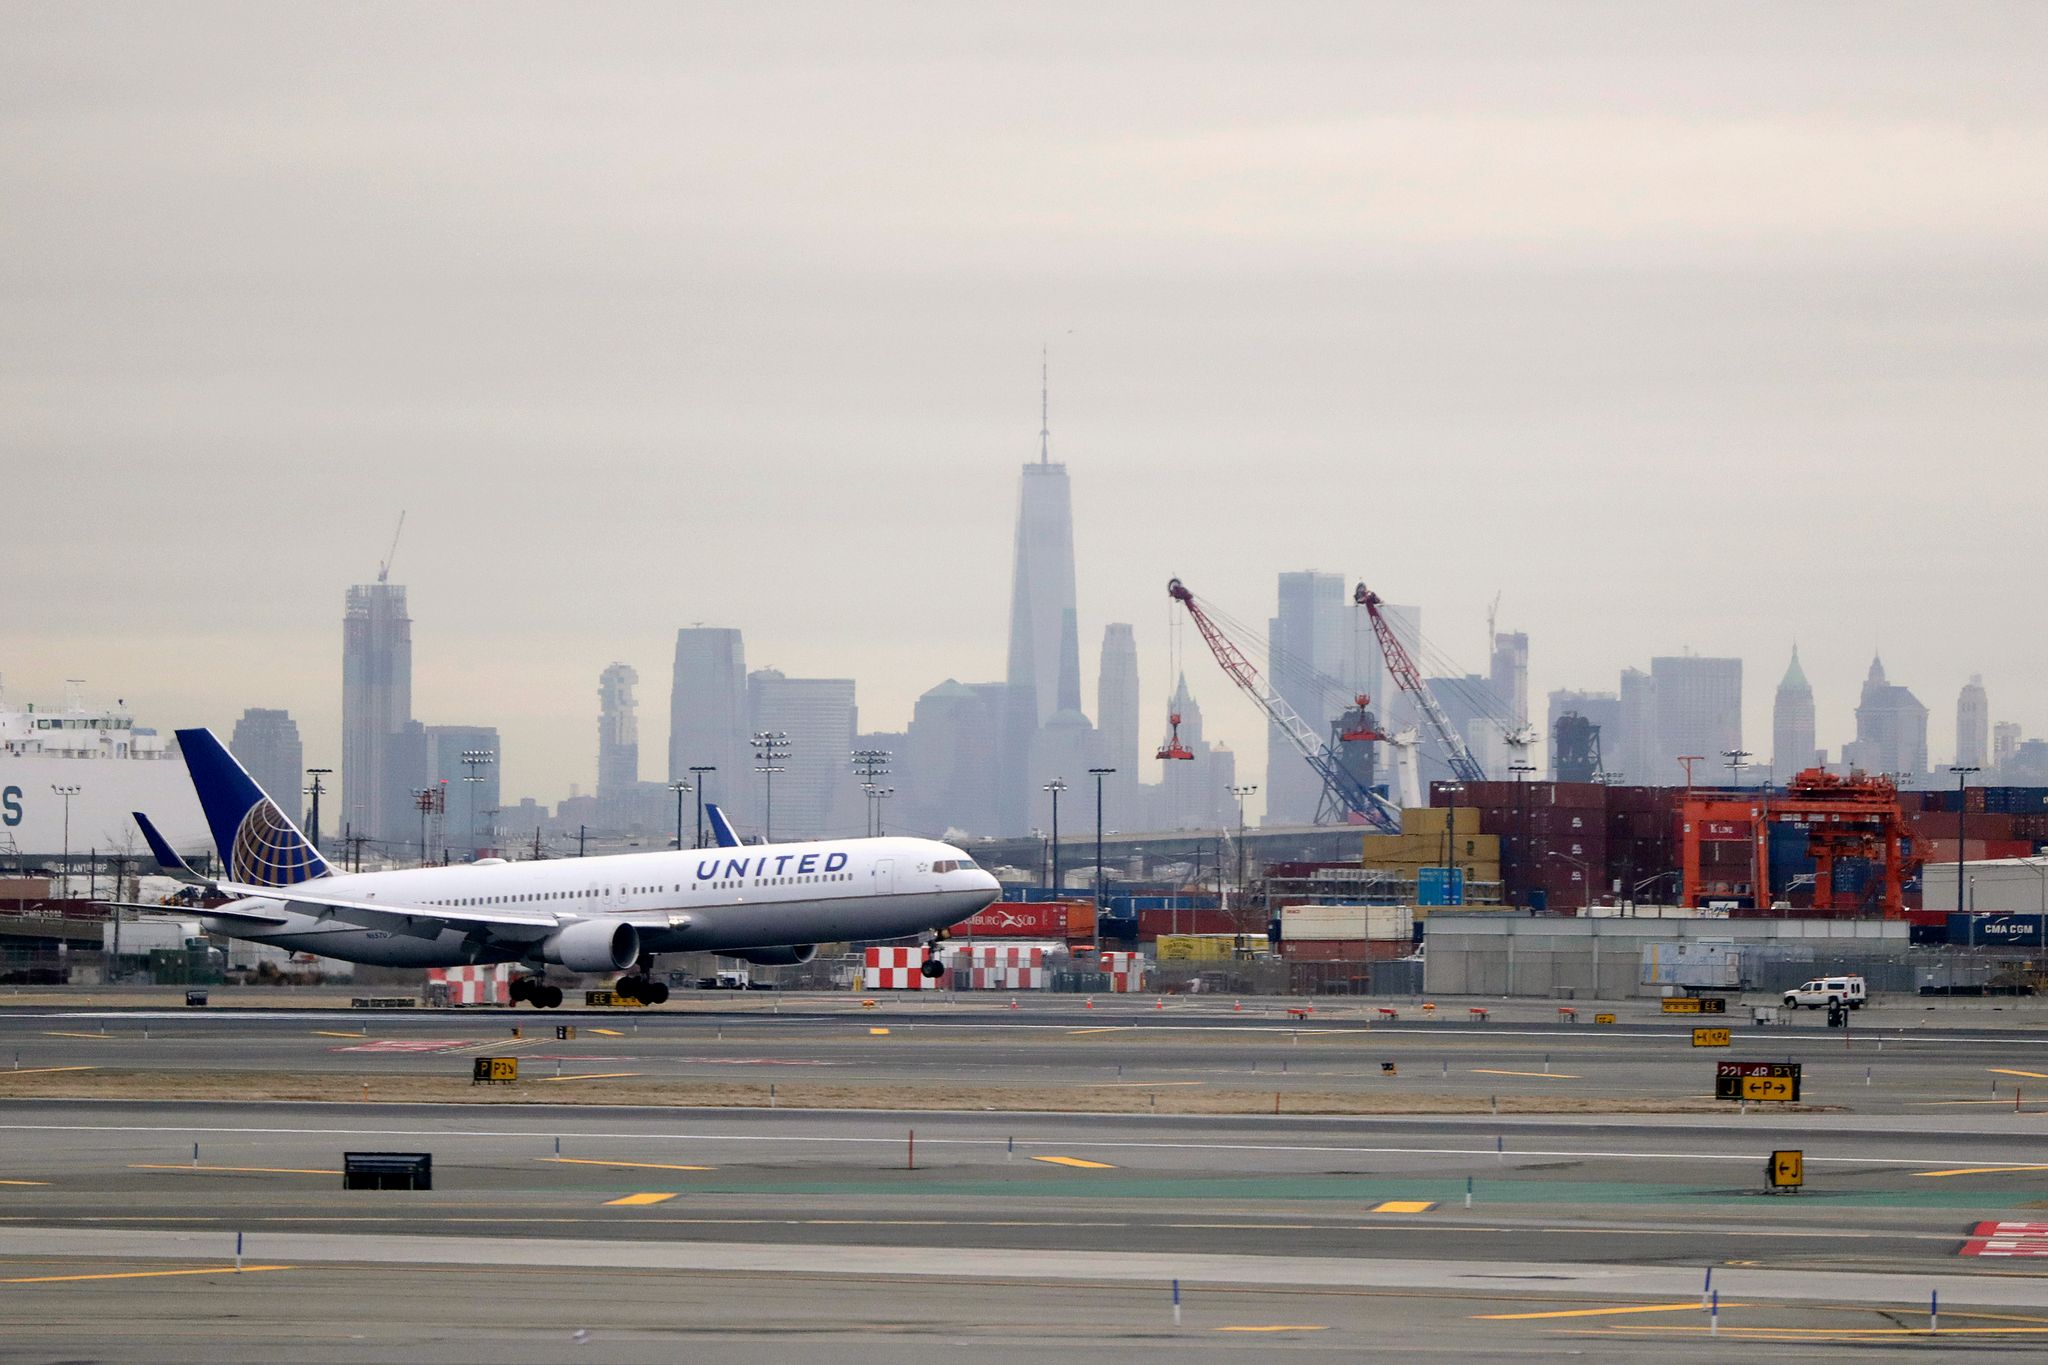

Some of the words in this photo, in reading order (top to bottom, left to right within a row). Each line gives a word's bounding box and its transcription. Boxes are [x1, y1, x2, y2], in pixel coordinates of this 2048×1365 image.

[696, 852, 849, 880] UNITED
[1985, 925, 2007, 933] CMA
[2010, 925, 2033, 933] CGM
[594, 994, 606, 1003] EE
[1705, 1001, 1718, 1010] EE
[481, 1062, 488, 1075] P
[493, 1062, 507, 1075] P3
[1726, 1080, 1735, 1095] J
[1762, 1081, 1773, 1095] P
[1791, 1158, 1799, 1178] J
